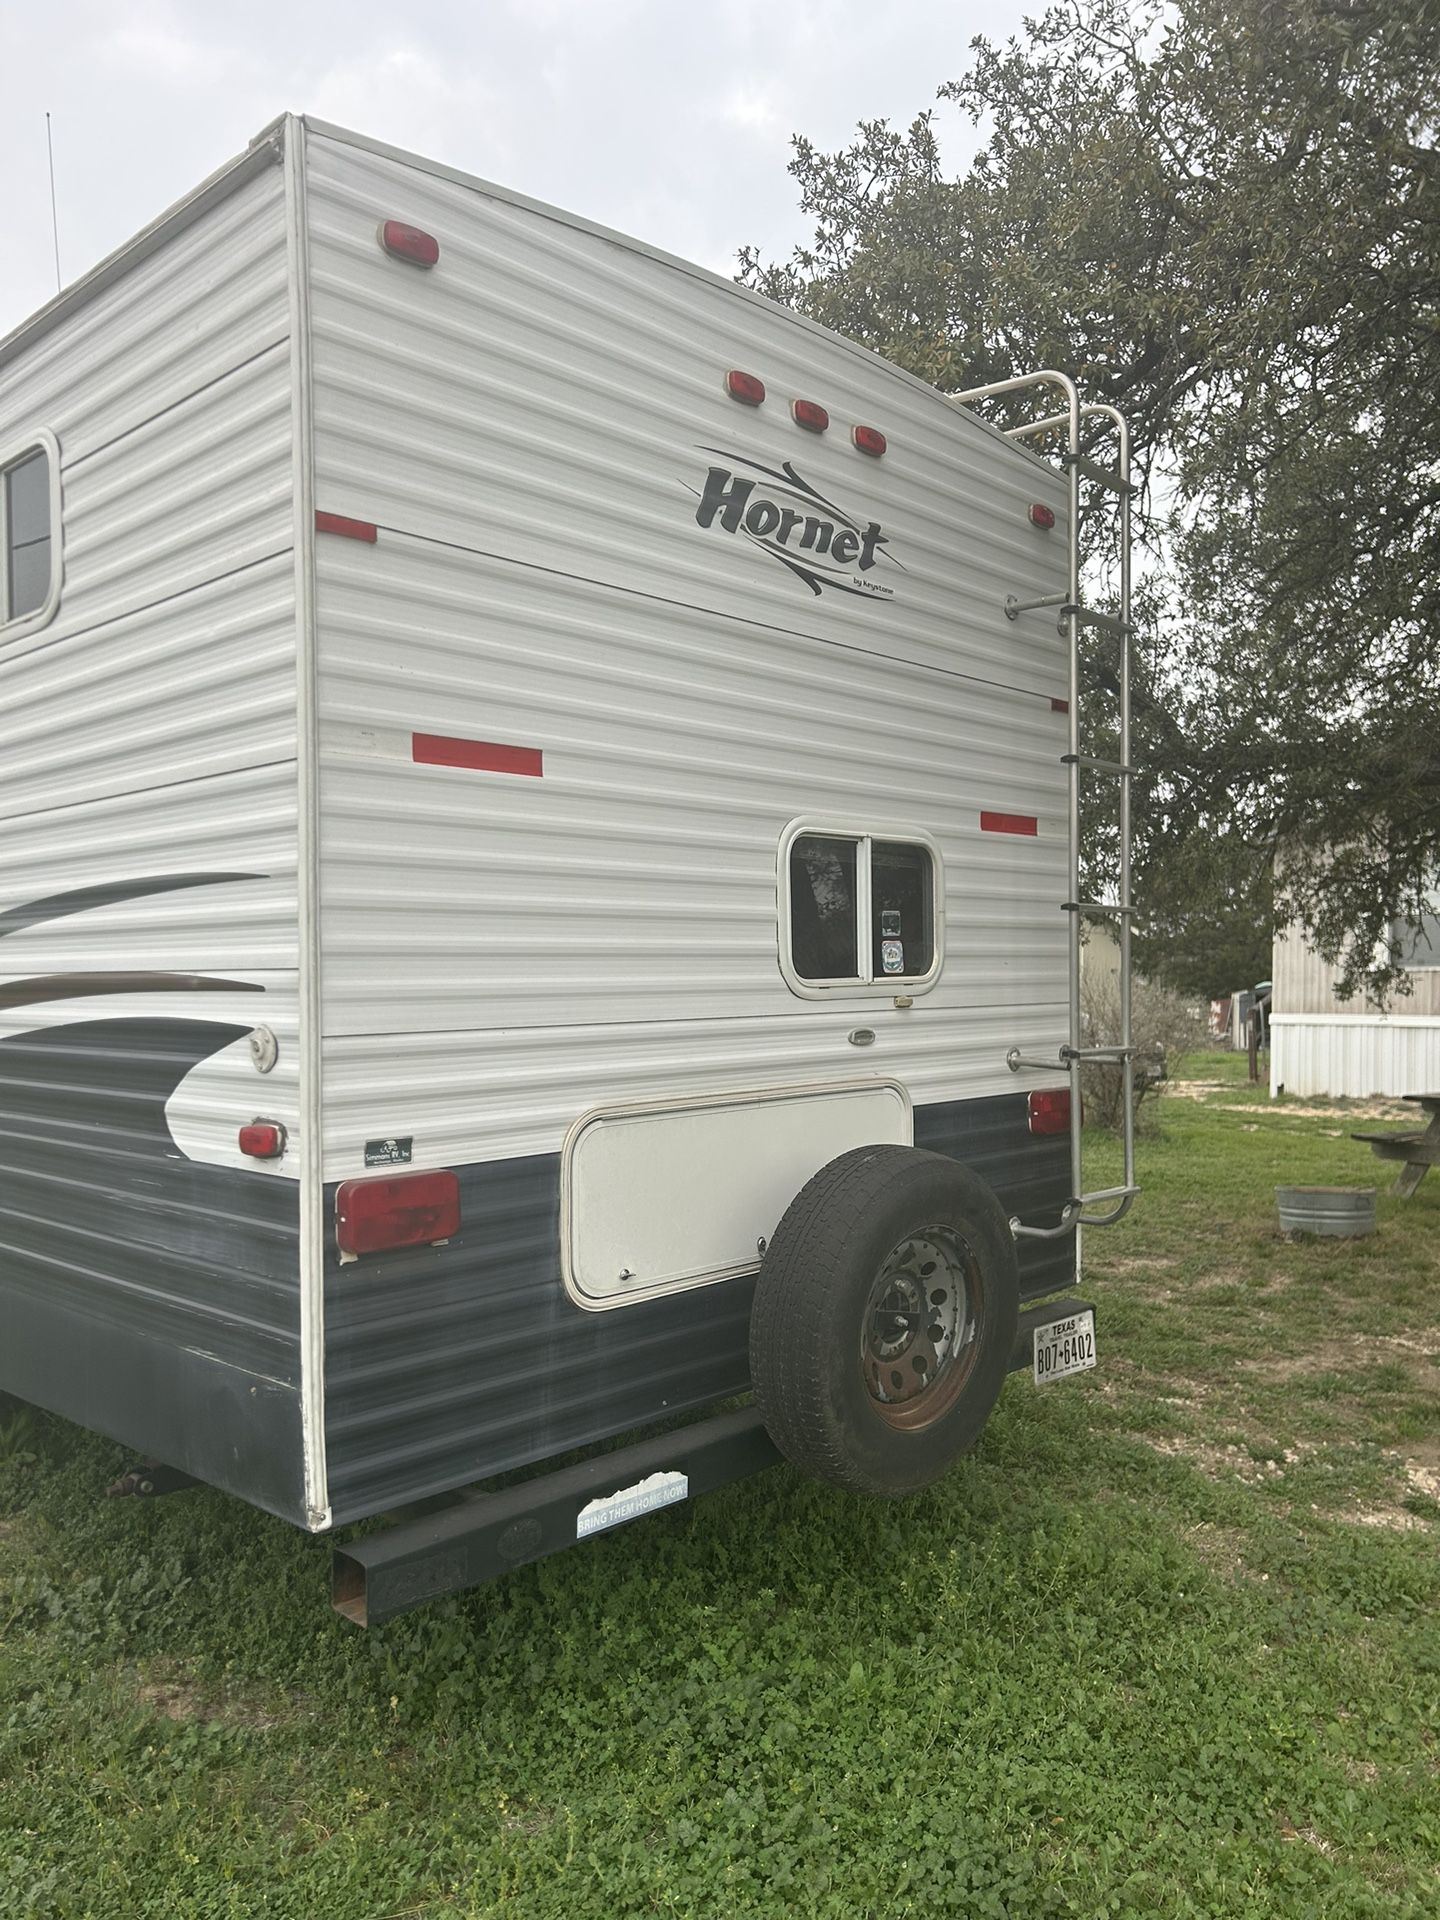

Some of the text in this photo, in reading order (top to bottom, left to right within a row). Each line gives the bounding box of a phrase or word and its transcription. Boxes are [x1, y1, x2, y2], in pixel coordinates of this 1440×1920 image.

[695, 466, 889, 572] Hornet
[853, 576, 894, 594] by Keystone
[1052, 1320, 1076, 1336] TEXAS
[577, 1512, 608, 1532] BRING
[608, 1503, 634, 1521] THEM
[635, 1494, 661, 1512] HOME
